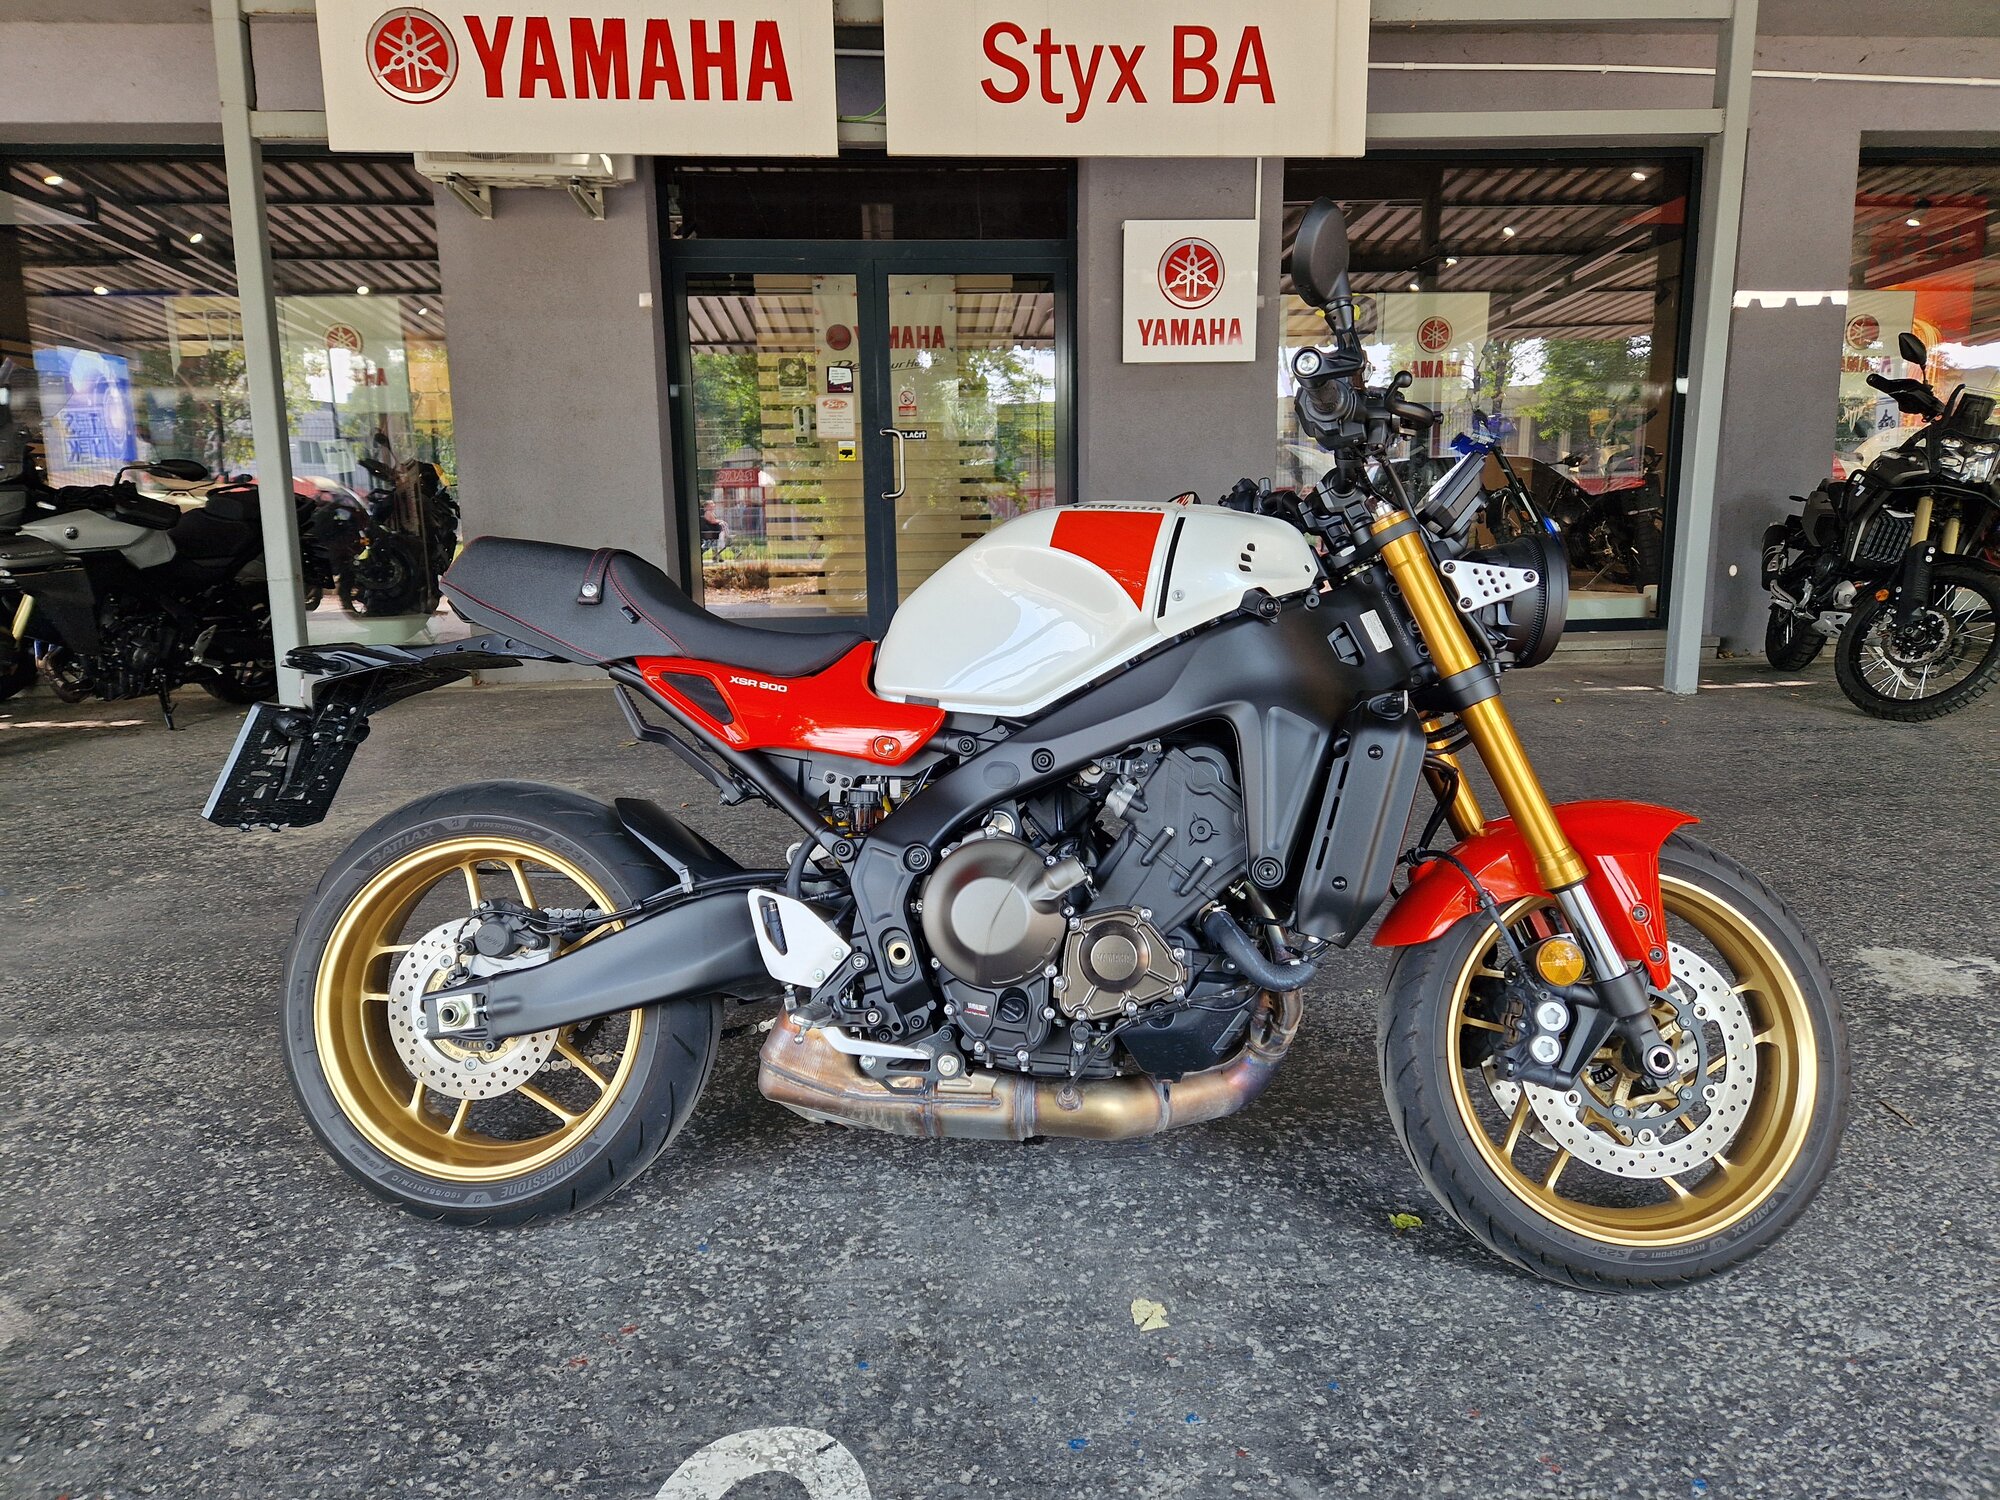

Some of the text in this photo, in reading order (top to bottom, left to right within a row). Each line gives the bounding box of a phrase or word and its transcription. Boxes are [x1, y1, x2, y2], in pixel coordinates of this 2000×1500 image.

[463, 16, 793, 102] YAMAHA
[980, 21, 1276, 123] Styx BA
[1137, 318, 1243, 346] YAMAHA
[729, 676, 788, 693] XSR 900
